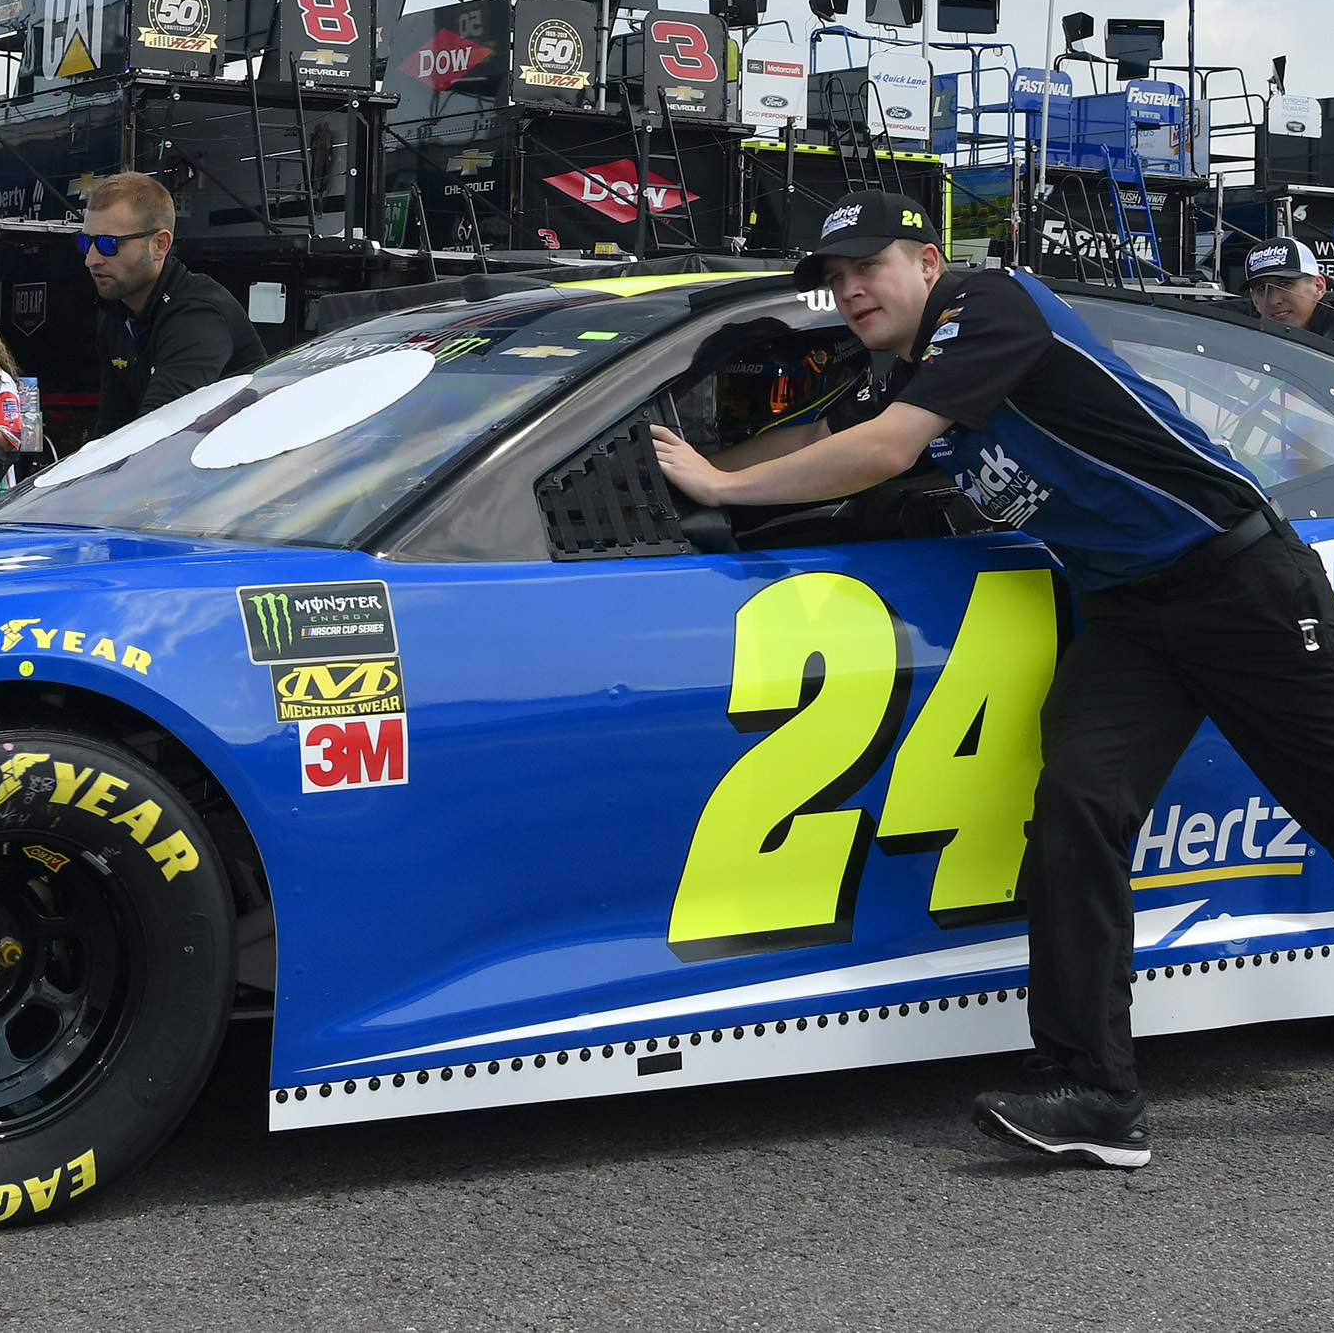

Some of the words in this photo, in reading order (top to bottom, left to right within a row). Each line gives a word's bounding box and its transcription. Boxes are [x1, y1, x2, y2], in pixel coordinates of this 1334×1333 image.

[168, 36, 208, 51] RCR
[537, 37, 575, 64] 50
[650, 20, 719, 83] 3
[417, 46, 473, 79] DOW
[766, 63, 801, 76] Motorcraft
[299, 67, 351, 78] CHEVROLET
[548, 74, 584, 88] RCR
[881, 72, 904, 85] Quick
[904, 75, 927, 87] Lane
[763, 96, 786, 108] Ford
[1127, 86, 1182, 108] FASTENAL
[888, 108, 910, 119] Ford
[885, 123, 926, 132] PERFORMANCE
[902, 210, 923, 229] 24
[1292, 204, 1308, 222] 6
[538, 228, 561, 249] 3
[1249, 245, 1289, 267] Hendrick
[294, 595, 383, 614] MONSTER
[311, 613, 371, 623] ENERGY
[310, 625, 342, 637] NASCAR
[342, 625, 357, 635] CUP
[357, 623, 384, 634] SERIES
[279, 702, 356, 719] MECHANIX
[358, 695, 402, 713] WEAR
[305, 719, 404, 787] 3M
[667, 568, 1059, 951] 24
[1130, 795, 1308, 873] Hertz
[30, 847, 62, 865] AERO
